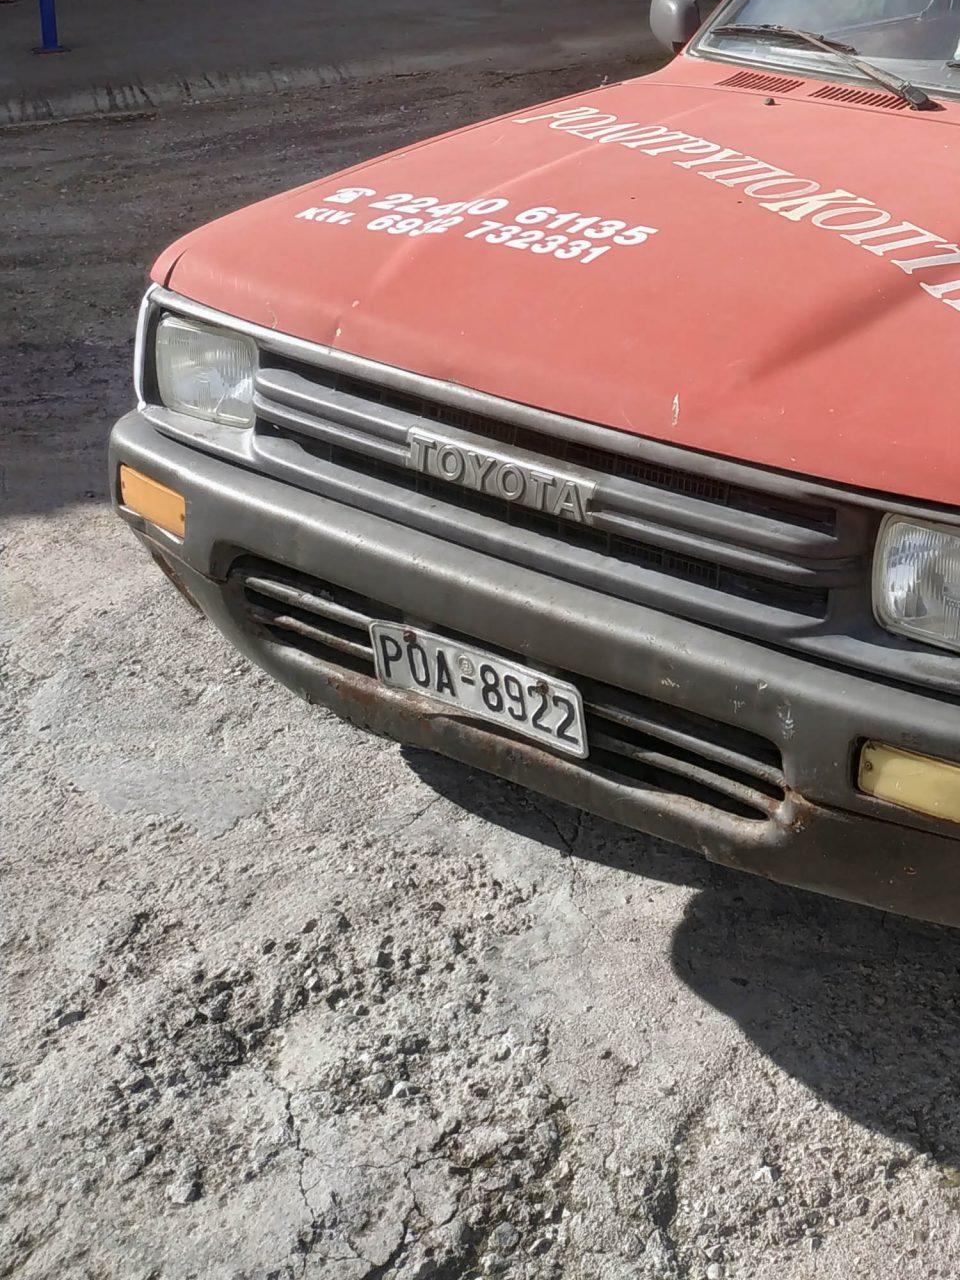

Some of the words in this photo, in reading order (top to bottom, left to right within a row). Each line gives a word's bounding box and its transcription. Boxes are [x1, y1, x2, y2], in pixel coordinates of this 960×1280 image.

[366, 214, 465, 237] 6932
[464, 220, 612, 264] 732331
[515, 206, 659, 247] 61135
[410, 432, 590, 522] TOYOTA
